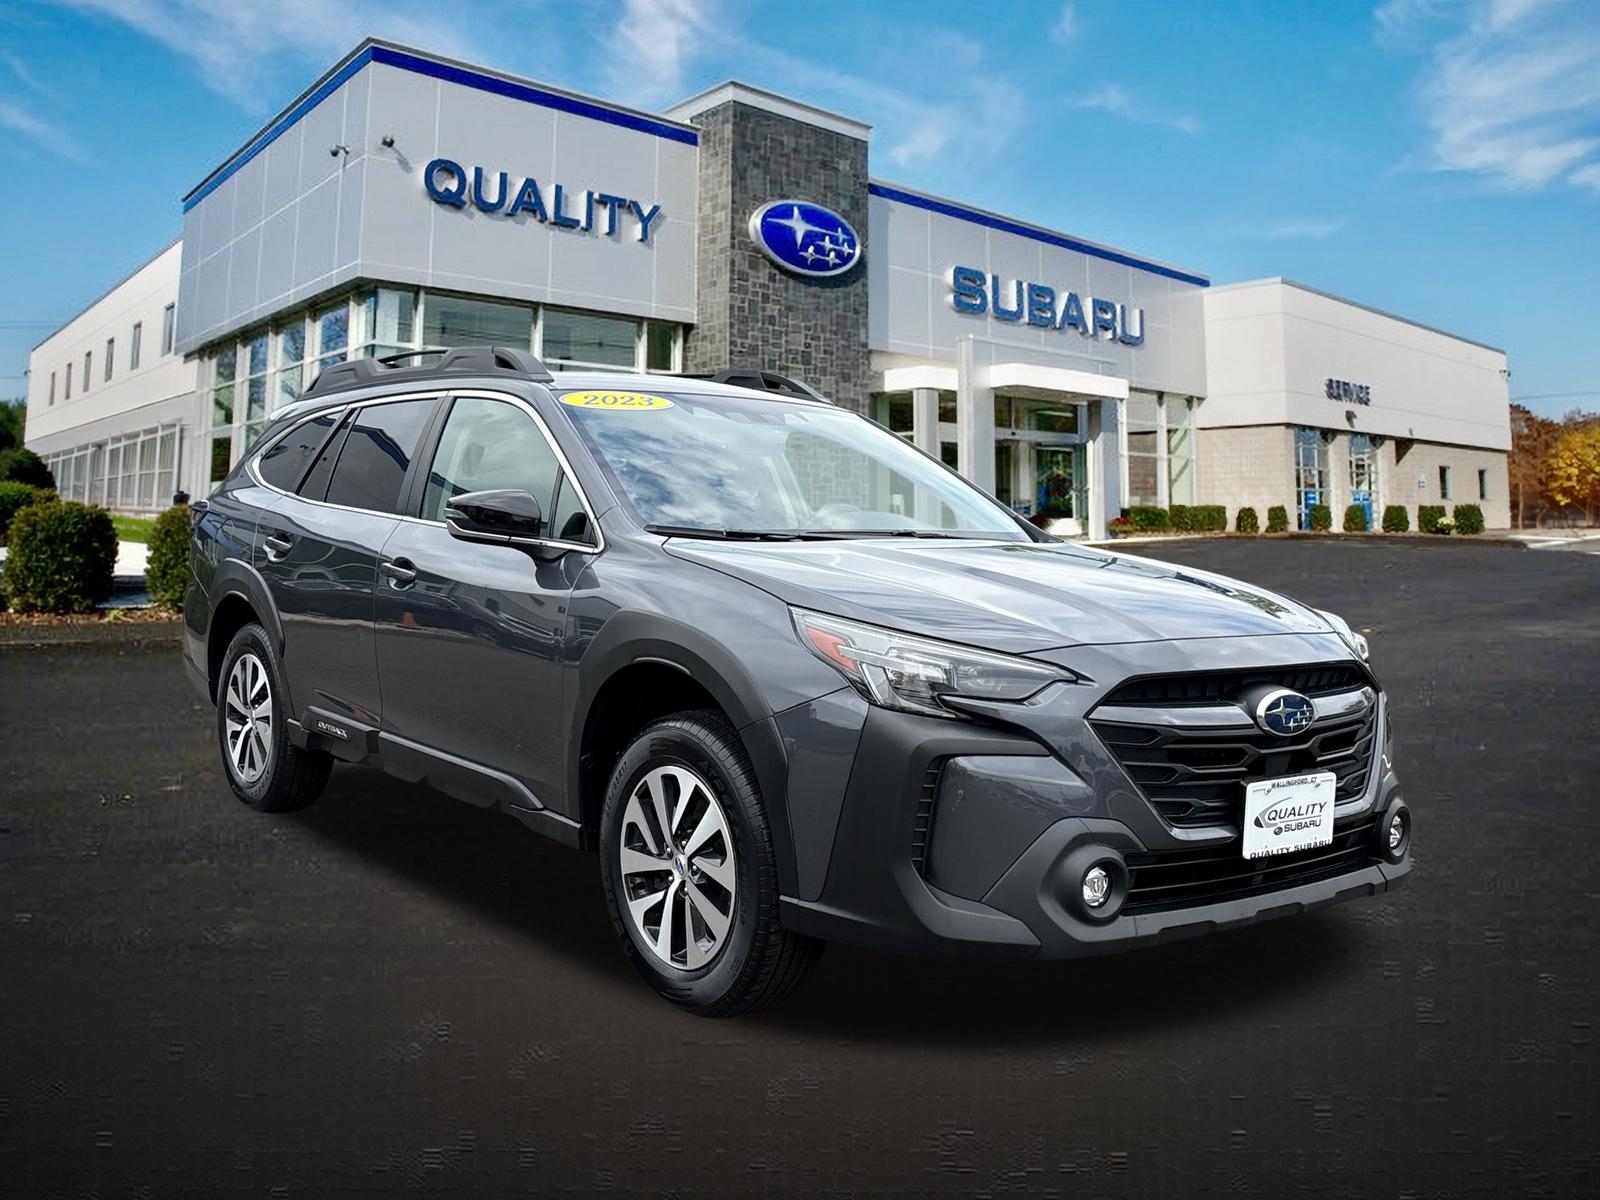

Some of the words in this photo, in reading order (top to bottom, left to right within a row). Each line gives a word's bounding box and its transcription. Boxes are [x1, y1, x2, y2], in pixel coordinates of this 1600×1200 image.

[423, 158, 663, 242] QUALITY
[950, 265, 1145, 346] SUBARU
[583, 394, 654, 406] 2023
[1267, 801, 1327, 821] QUALITY
[1283, 818, 1321, 832] SUBARU
[1249, 846, 1291, 860] QUALITY
[1293, 839, 1332, 853] SUBARU
